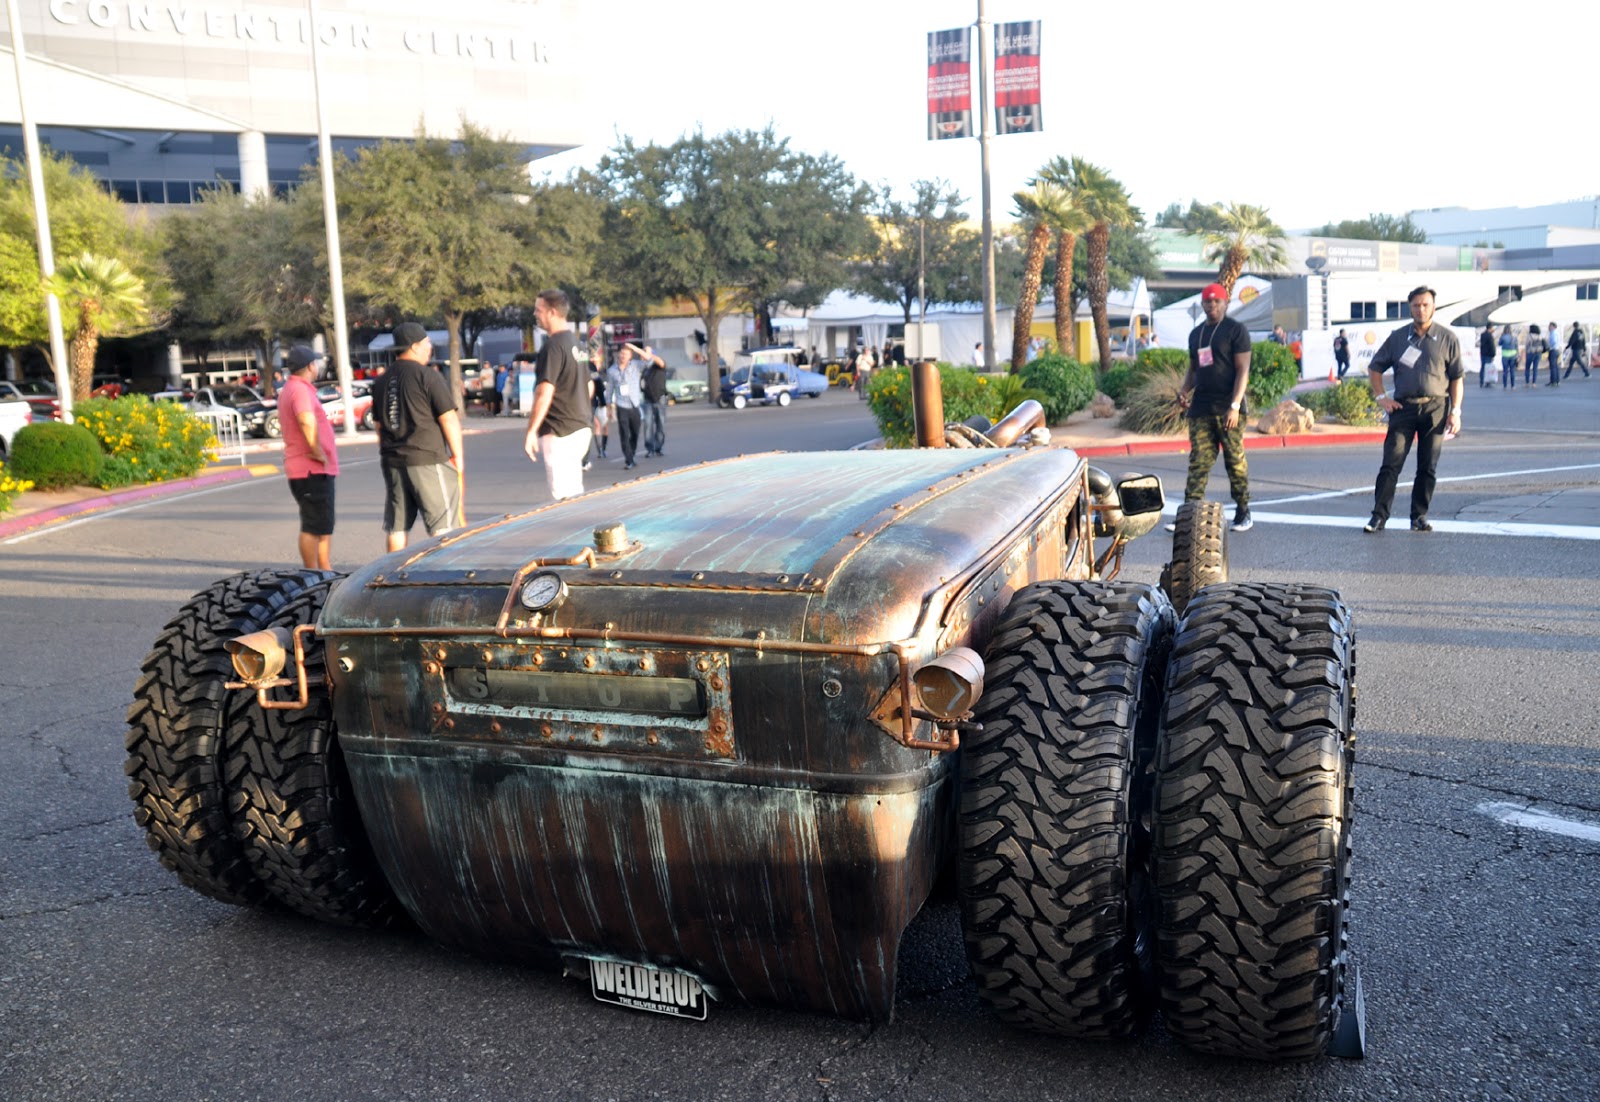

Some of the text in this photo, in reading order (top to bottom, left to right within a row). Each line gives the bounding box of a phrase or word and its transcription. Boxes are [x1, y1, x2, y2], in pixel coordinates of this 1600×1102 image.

[48, 0, 552, 64] CONVENTION CENTER
[1328, 246, 1347, 256] CUSTOM
[467, 671, 693, 712] STOP
[593, 960, 703, 1008] WELDERUP
[618, 996, 680, 1014] THE SILVER STATE
